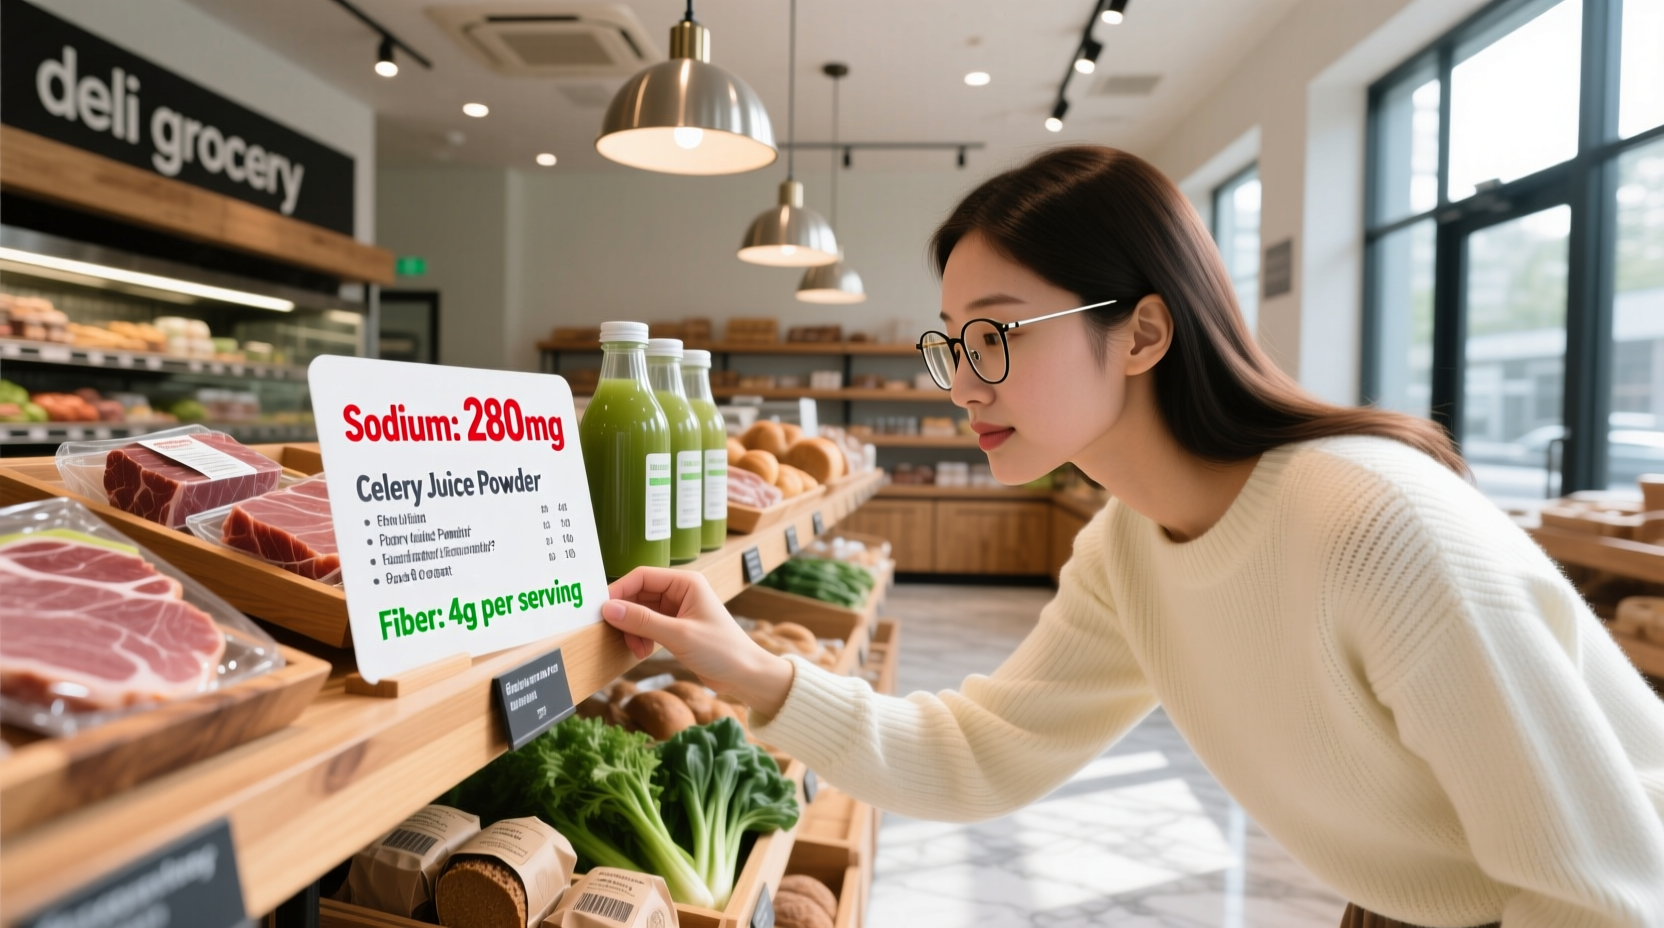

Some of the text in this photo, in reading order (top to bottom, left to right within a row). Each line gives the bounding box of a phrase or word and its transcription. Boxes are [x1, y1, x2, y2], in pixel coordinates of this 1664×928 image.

[36, 46, 304, 215] deli grocery
[342, 396, 566, 452] Sodium: 280mg
[356, 467, 541, 507] Celery Juice Powder
[377, 578, 584, 641] Fiber: 4g per serving
